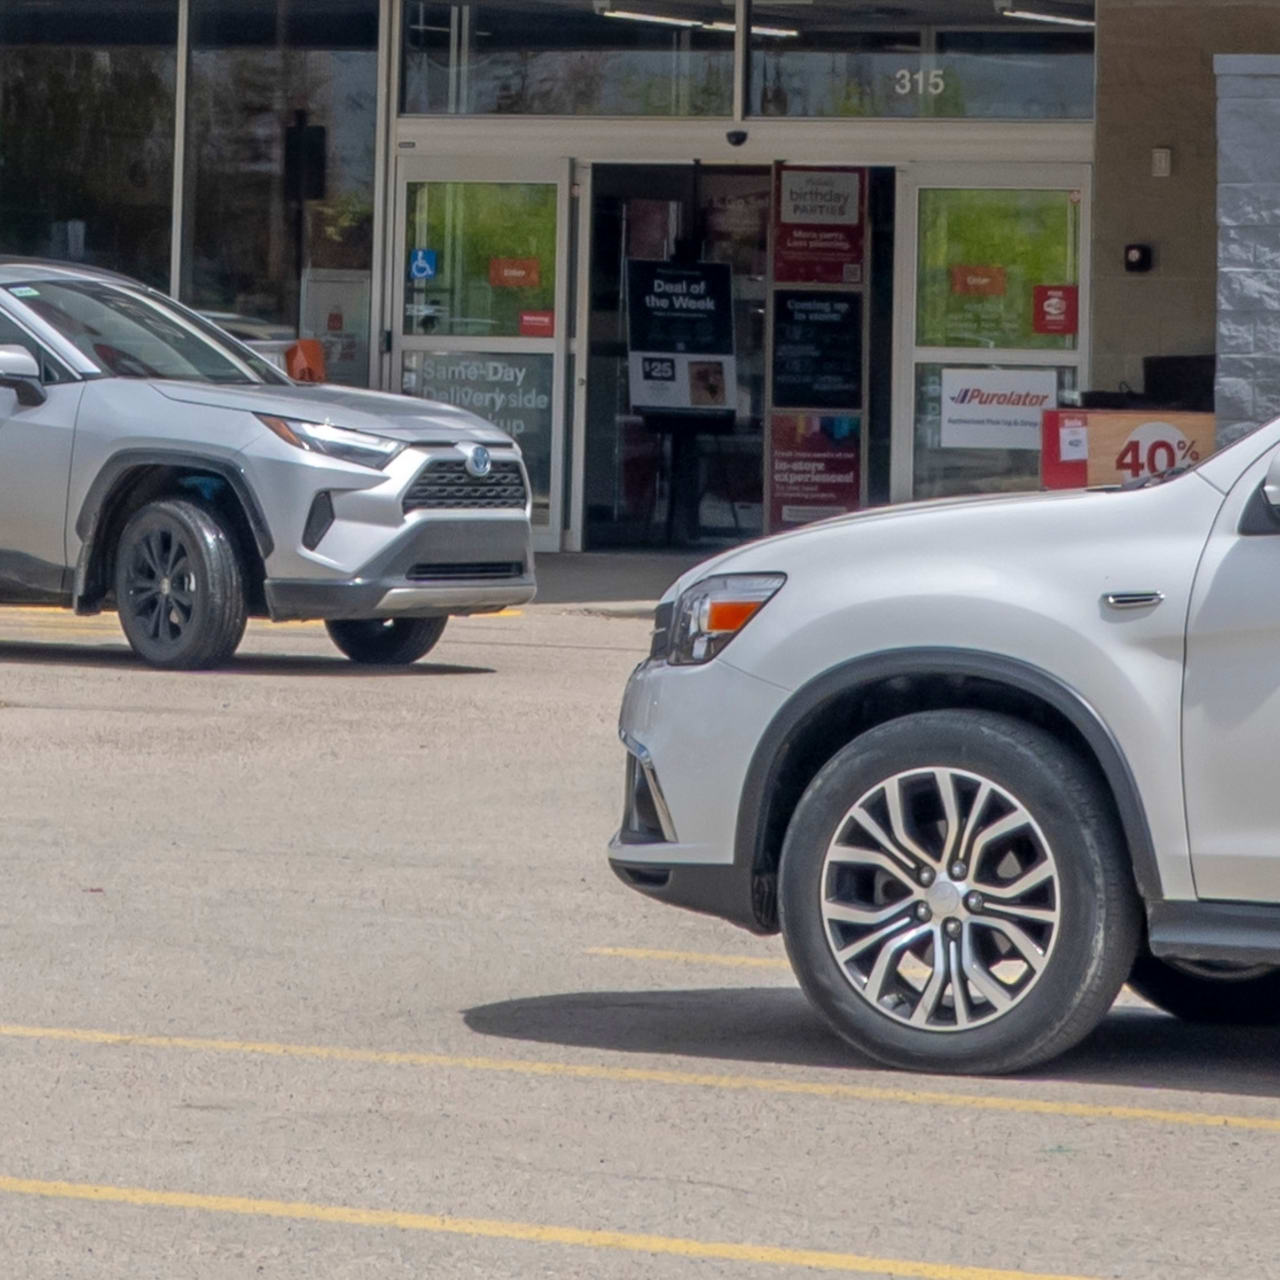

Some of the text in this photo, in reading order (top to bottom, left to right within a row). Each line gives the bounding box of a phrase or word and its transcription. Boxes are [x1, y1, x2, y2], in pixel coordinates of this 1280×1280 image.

[895, 69, 945, 95] 315
[789, 189, 850, 206] birthday
[653, 279, 707, 295] Deal of
[645, 295, 716, 311] the Week
[423, 360, 526, 386] Same-Day
[967, 388, 1050, 407] Purolator
[1115, 439, 1200, 478] 40%
